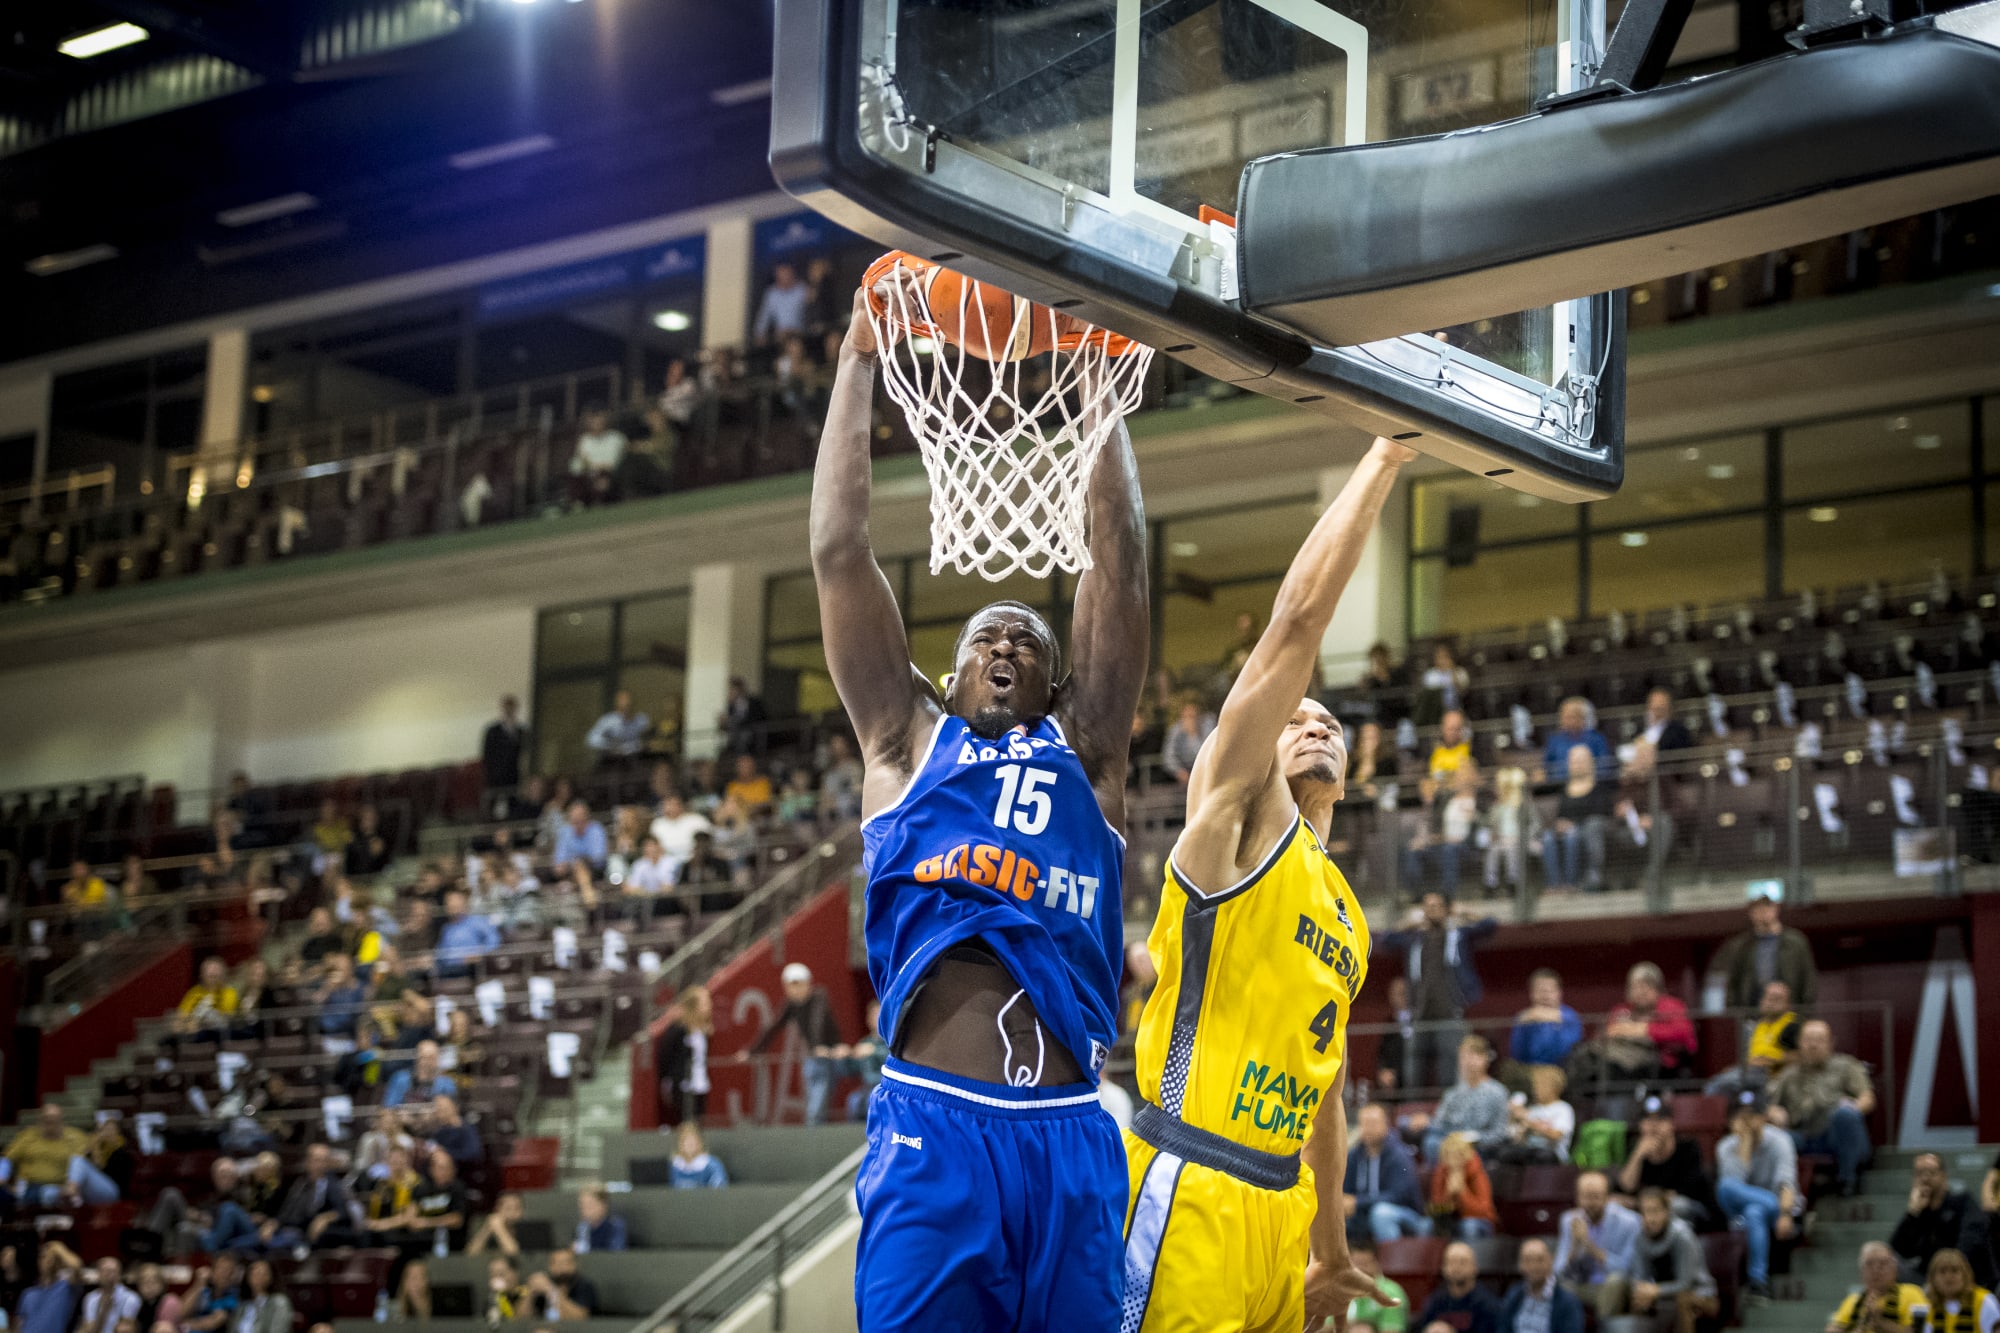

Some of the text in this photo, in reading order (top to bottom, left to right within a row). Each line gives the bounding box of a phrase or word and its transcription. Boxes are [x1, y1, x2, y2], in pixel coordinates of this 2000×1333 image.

[993, 764, 1058, 836] 15
[913, 843, 1100, 919] BASIC-FIT
[1308, 999, 1338, 1055] 4
